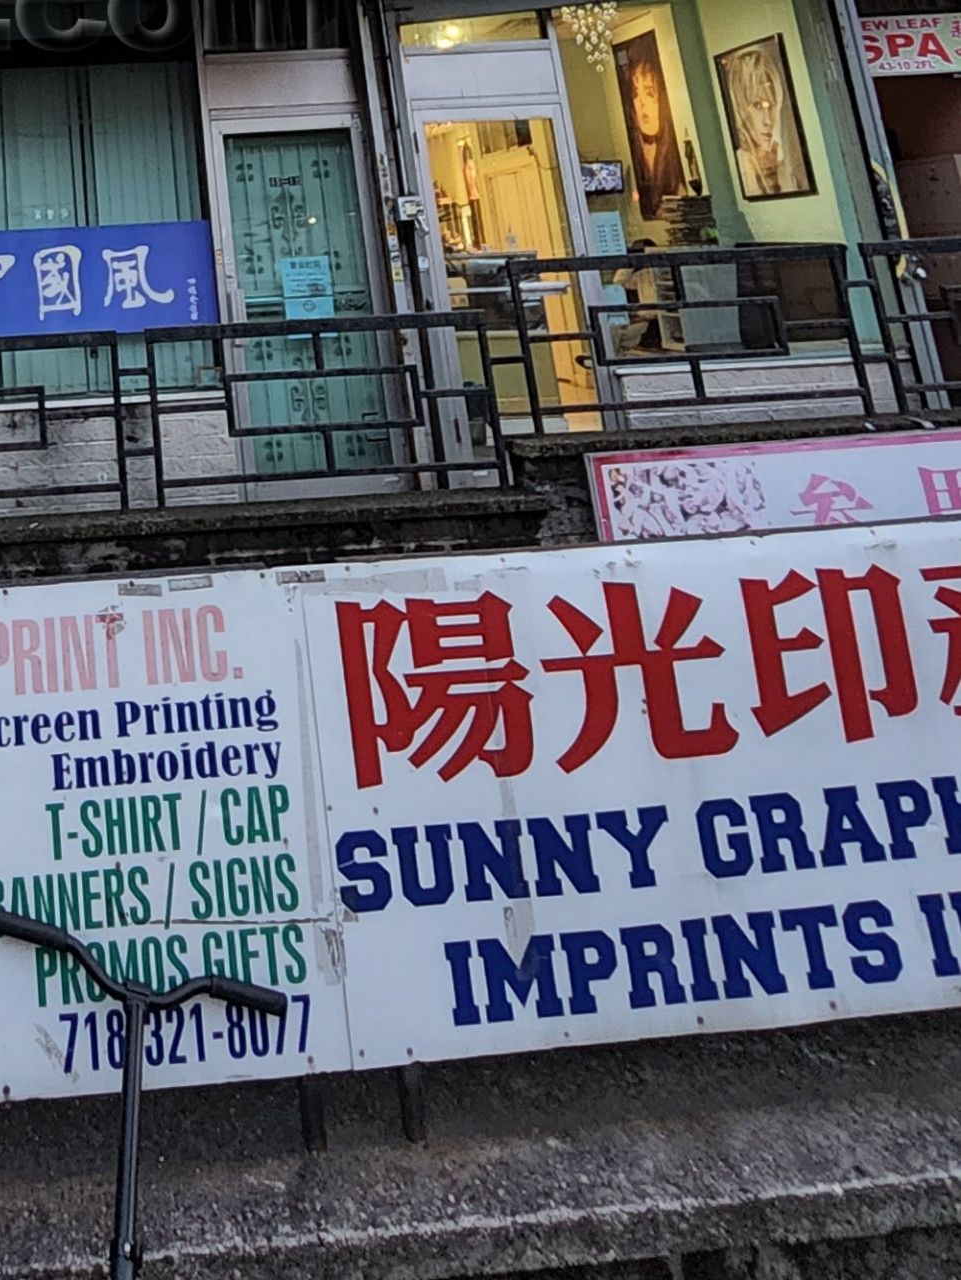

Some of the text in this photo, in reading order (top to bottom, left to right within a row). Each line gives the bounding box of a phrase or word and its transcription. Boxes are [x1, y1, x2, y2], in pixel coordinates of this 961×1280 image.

[861, 32, 954, 65] SPA
[894, 16, 943, 30] LEAF
[143, 603, 245, 686] INC.
[115, 689, 279, 738] Printing
[51, 740, 283, 792] Embroidery
[45, 791, 183, 861] T-SHIRT
[220, 783, 291, 849] CAP
[188, 852, 300, 922] SIGNS
[335, 804, 669, 914] SUNNY
[202, 922, 309, 986] GIFTS
[442, 898, 905, 1028] IMPRINTS
